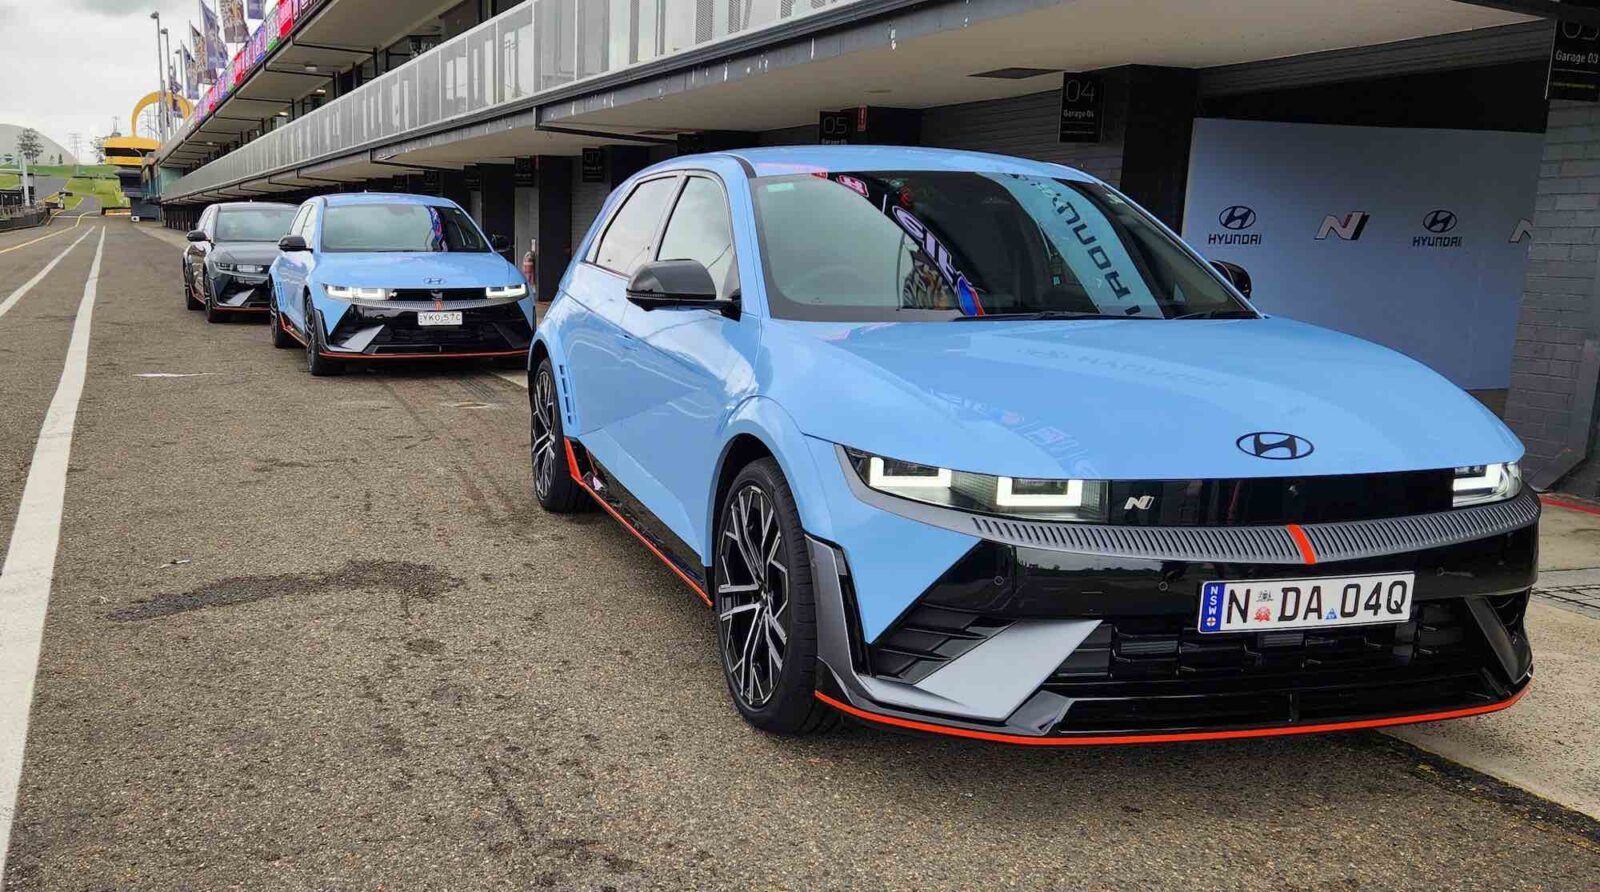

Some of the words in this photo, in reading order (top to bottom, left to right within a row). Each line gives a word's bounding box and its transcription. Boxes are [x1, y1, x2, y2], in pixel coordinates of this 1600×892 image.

[1555, 50, 1586, 64] Garage
[1587, 53, 1600, 64] 03
[1066, 79, 1096, 104] 04
[1063, 109, 1086, 119] Garage
[822, 115, 849, 135] 05
[1208, 233, 1262, 246] HYUNDAI
[1412, 236, 1463, 248] HYUNDAI
[1209, 586, 1219, 616] NSW
[1226, 588, 1251, 625] N
[1277, 585, 1323, 622] DA
